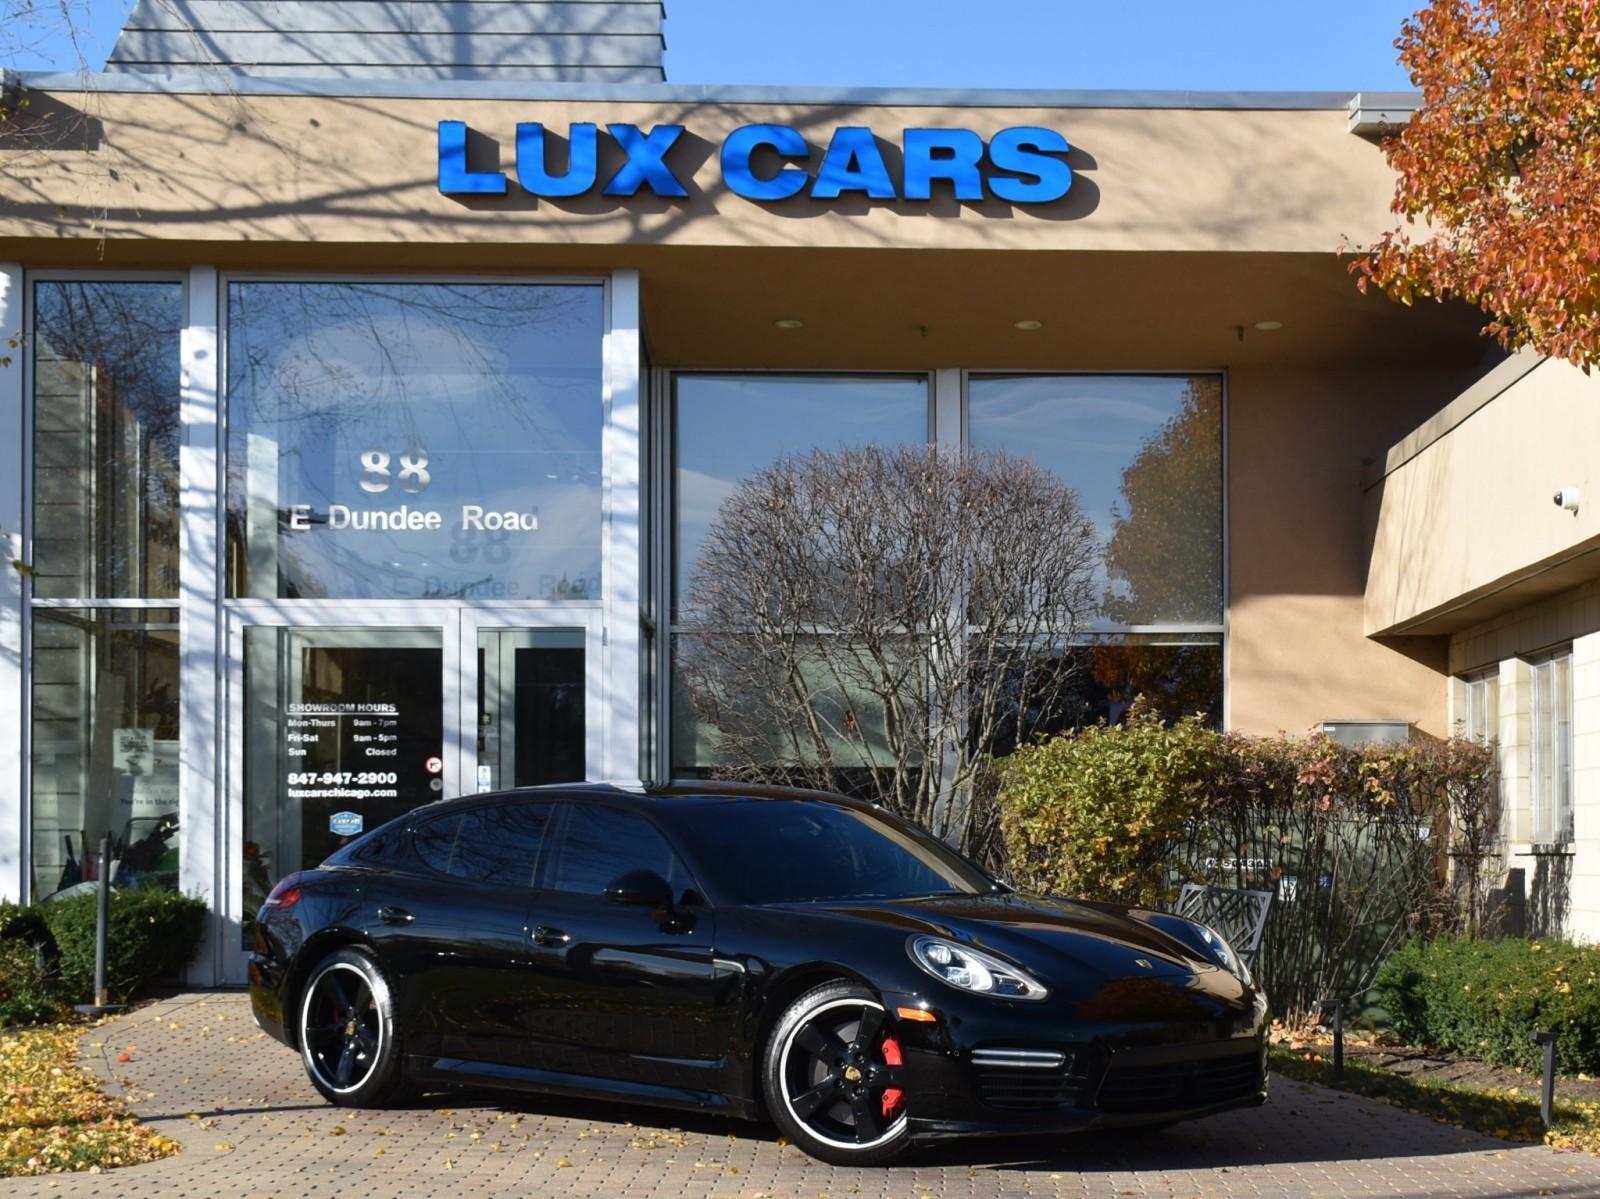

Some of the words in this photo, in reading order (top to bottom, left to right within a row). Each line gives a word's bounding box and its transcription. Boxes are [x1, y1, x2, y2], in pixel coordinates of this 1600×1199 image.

[438, 120, 689, 199] LUX
[719, 122, 1073, 203] CARS
[359, 447, 431, 494] 88
[290, 504, 312, 530] E
[328, 505, 442, 531] Dundee
[462, 505, 539, 531] Road
[289, 703, 355, 713] SHOWROOM
[357, 703, 397, 713] HOURS
[287, 718, 336, 727] Mon-Thurs
[287, 733, 320, 742] Fri-Sat
[287, 747, 307, 756] Sun
[365, 747, 397, 756] Closed
[287, 772, 398, 785] 847-947-2900
[287, 787, 398, 799] luxcarschicago.com
